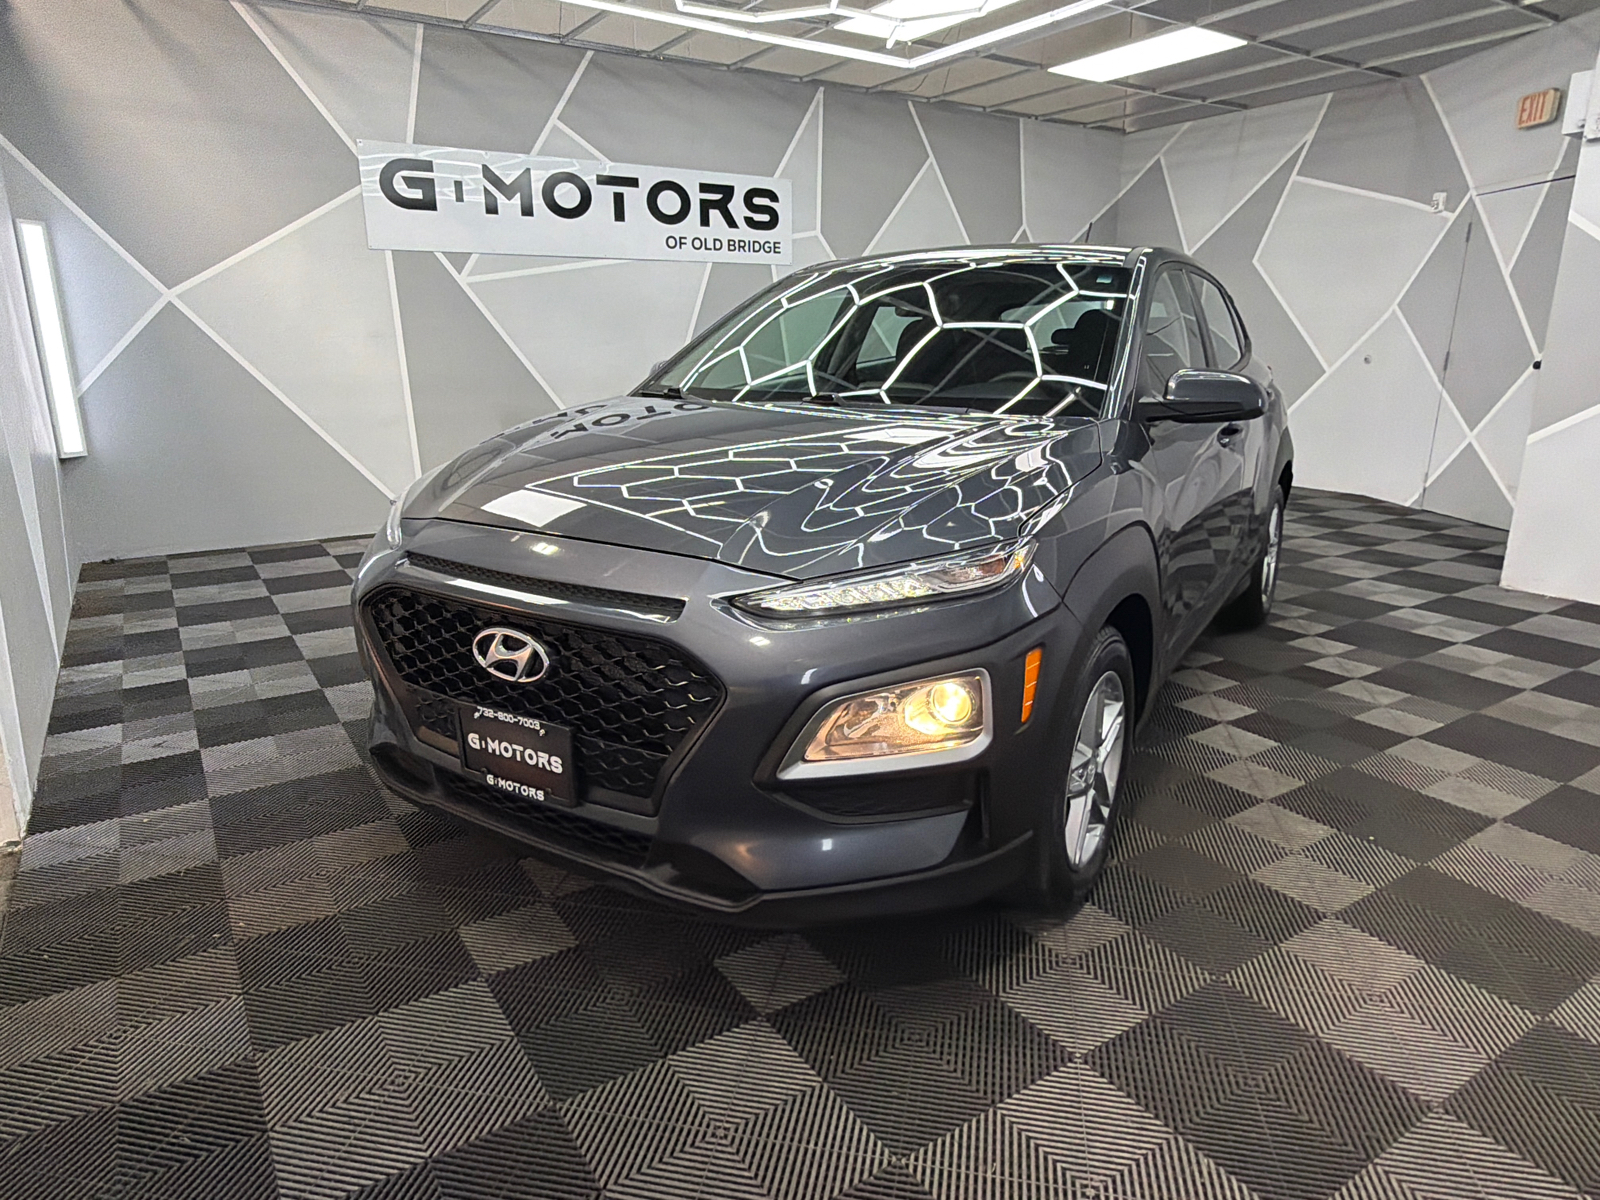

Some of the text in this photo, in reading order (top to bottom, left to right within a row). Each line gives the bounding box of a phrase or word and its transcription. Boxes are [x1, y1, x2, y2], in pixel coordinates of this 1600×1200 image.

[1518, 91, 1549, 126] EXIT
[665, 235, 782, 255] OF OLD BRIDGE
[476, 705, 541, 731] 732-800-7003
